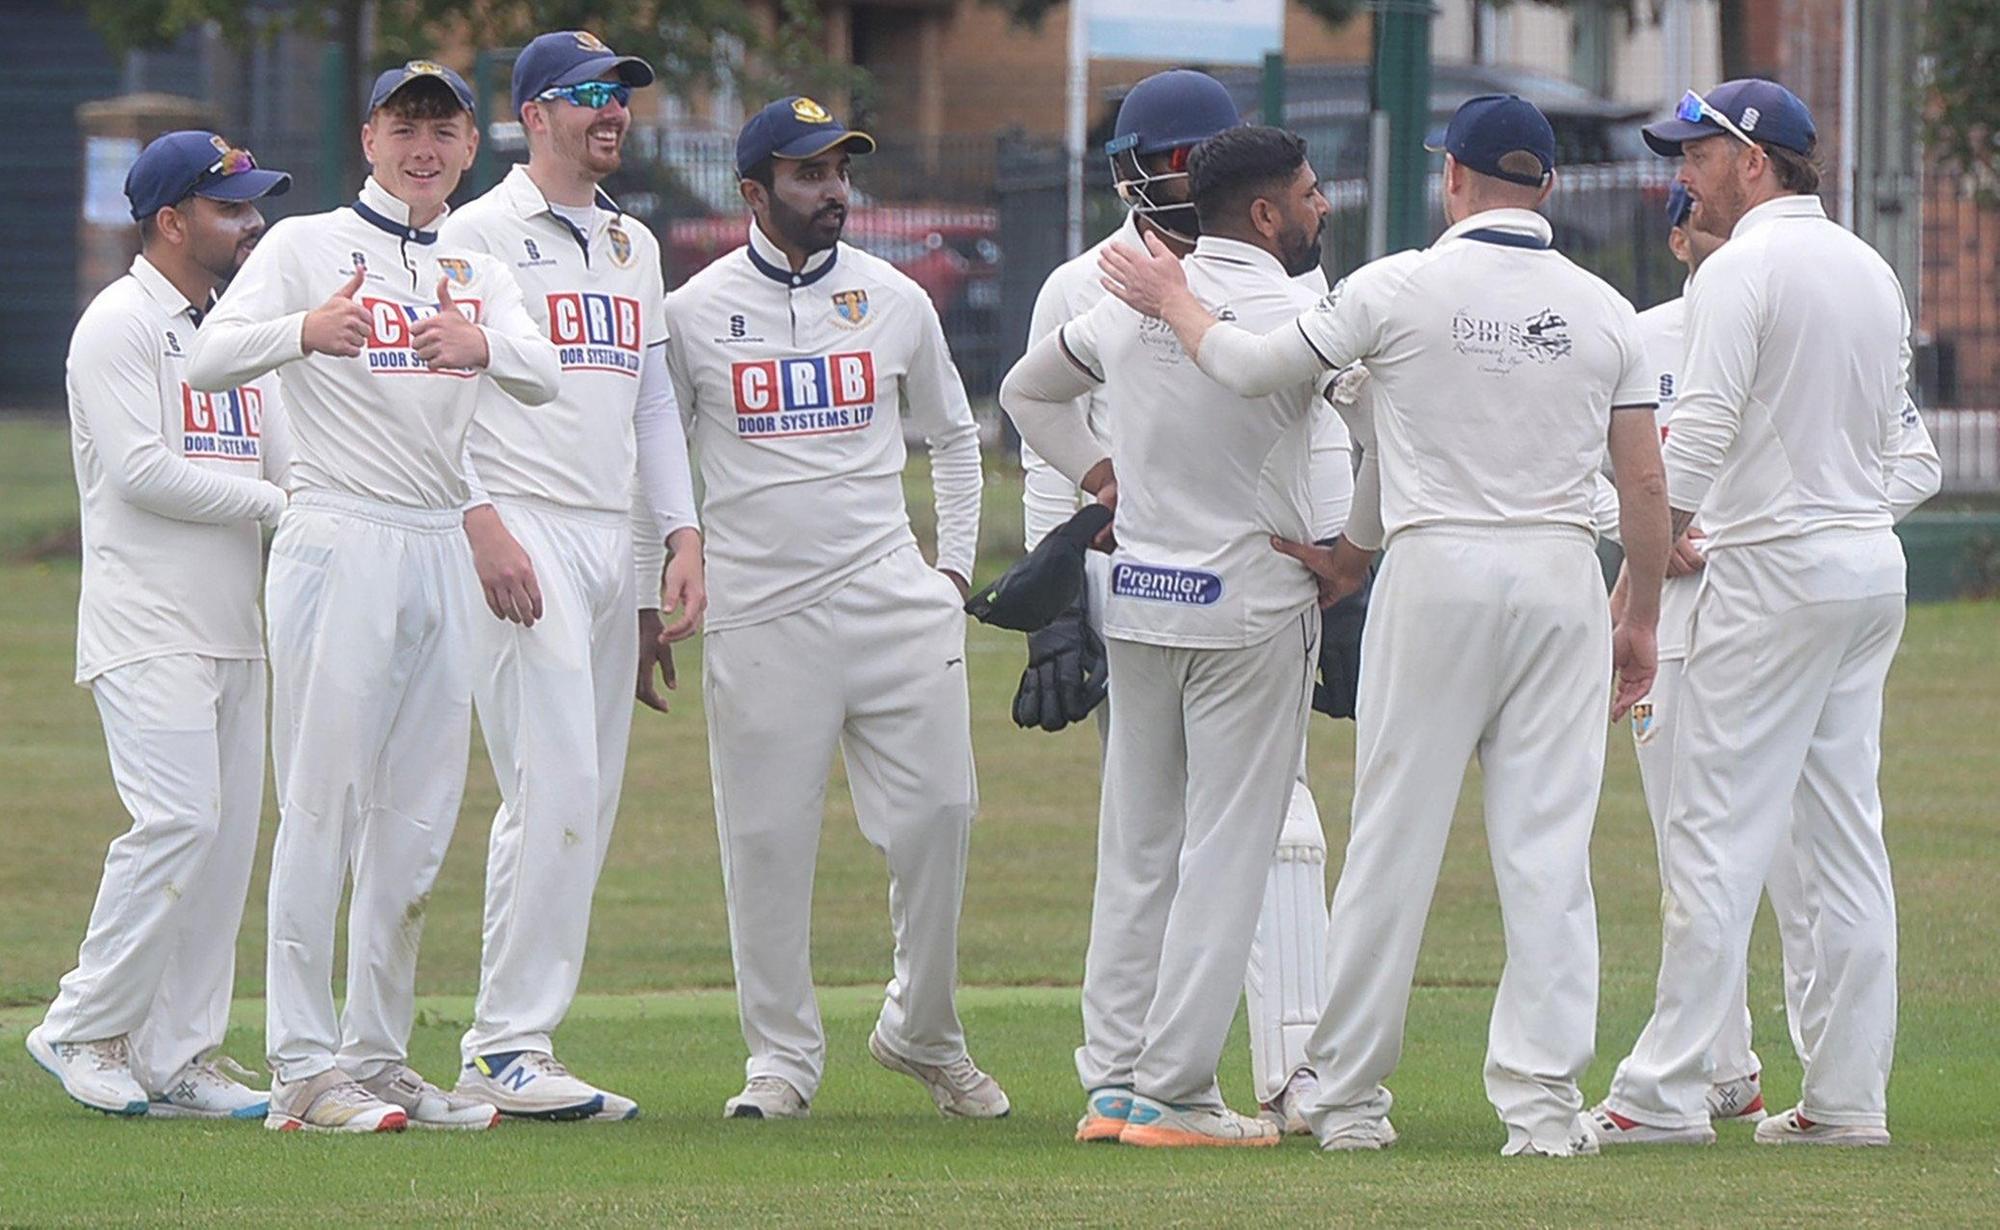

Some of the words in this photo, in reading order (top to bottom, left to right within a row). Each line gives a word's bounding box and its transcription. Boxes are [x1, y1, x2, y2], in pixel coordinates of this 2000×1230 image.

[555, 297, 636, 345] CRB
[368, 352, 408, 368] DOOR
[559, 349, 585, 365] OOR
[588, 349, 626, 366] SYSTEMS
[740, 356, 867, 411] CRB
[738, 414, 777, 433] DOOR
[780, 409, 850, 431] SYSTEMS
[854, 406, 874, 423] LTD
[1118, 566, 1207, 593] Premier
